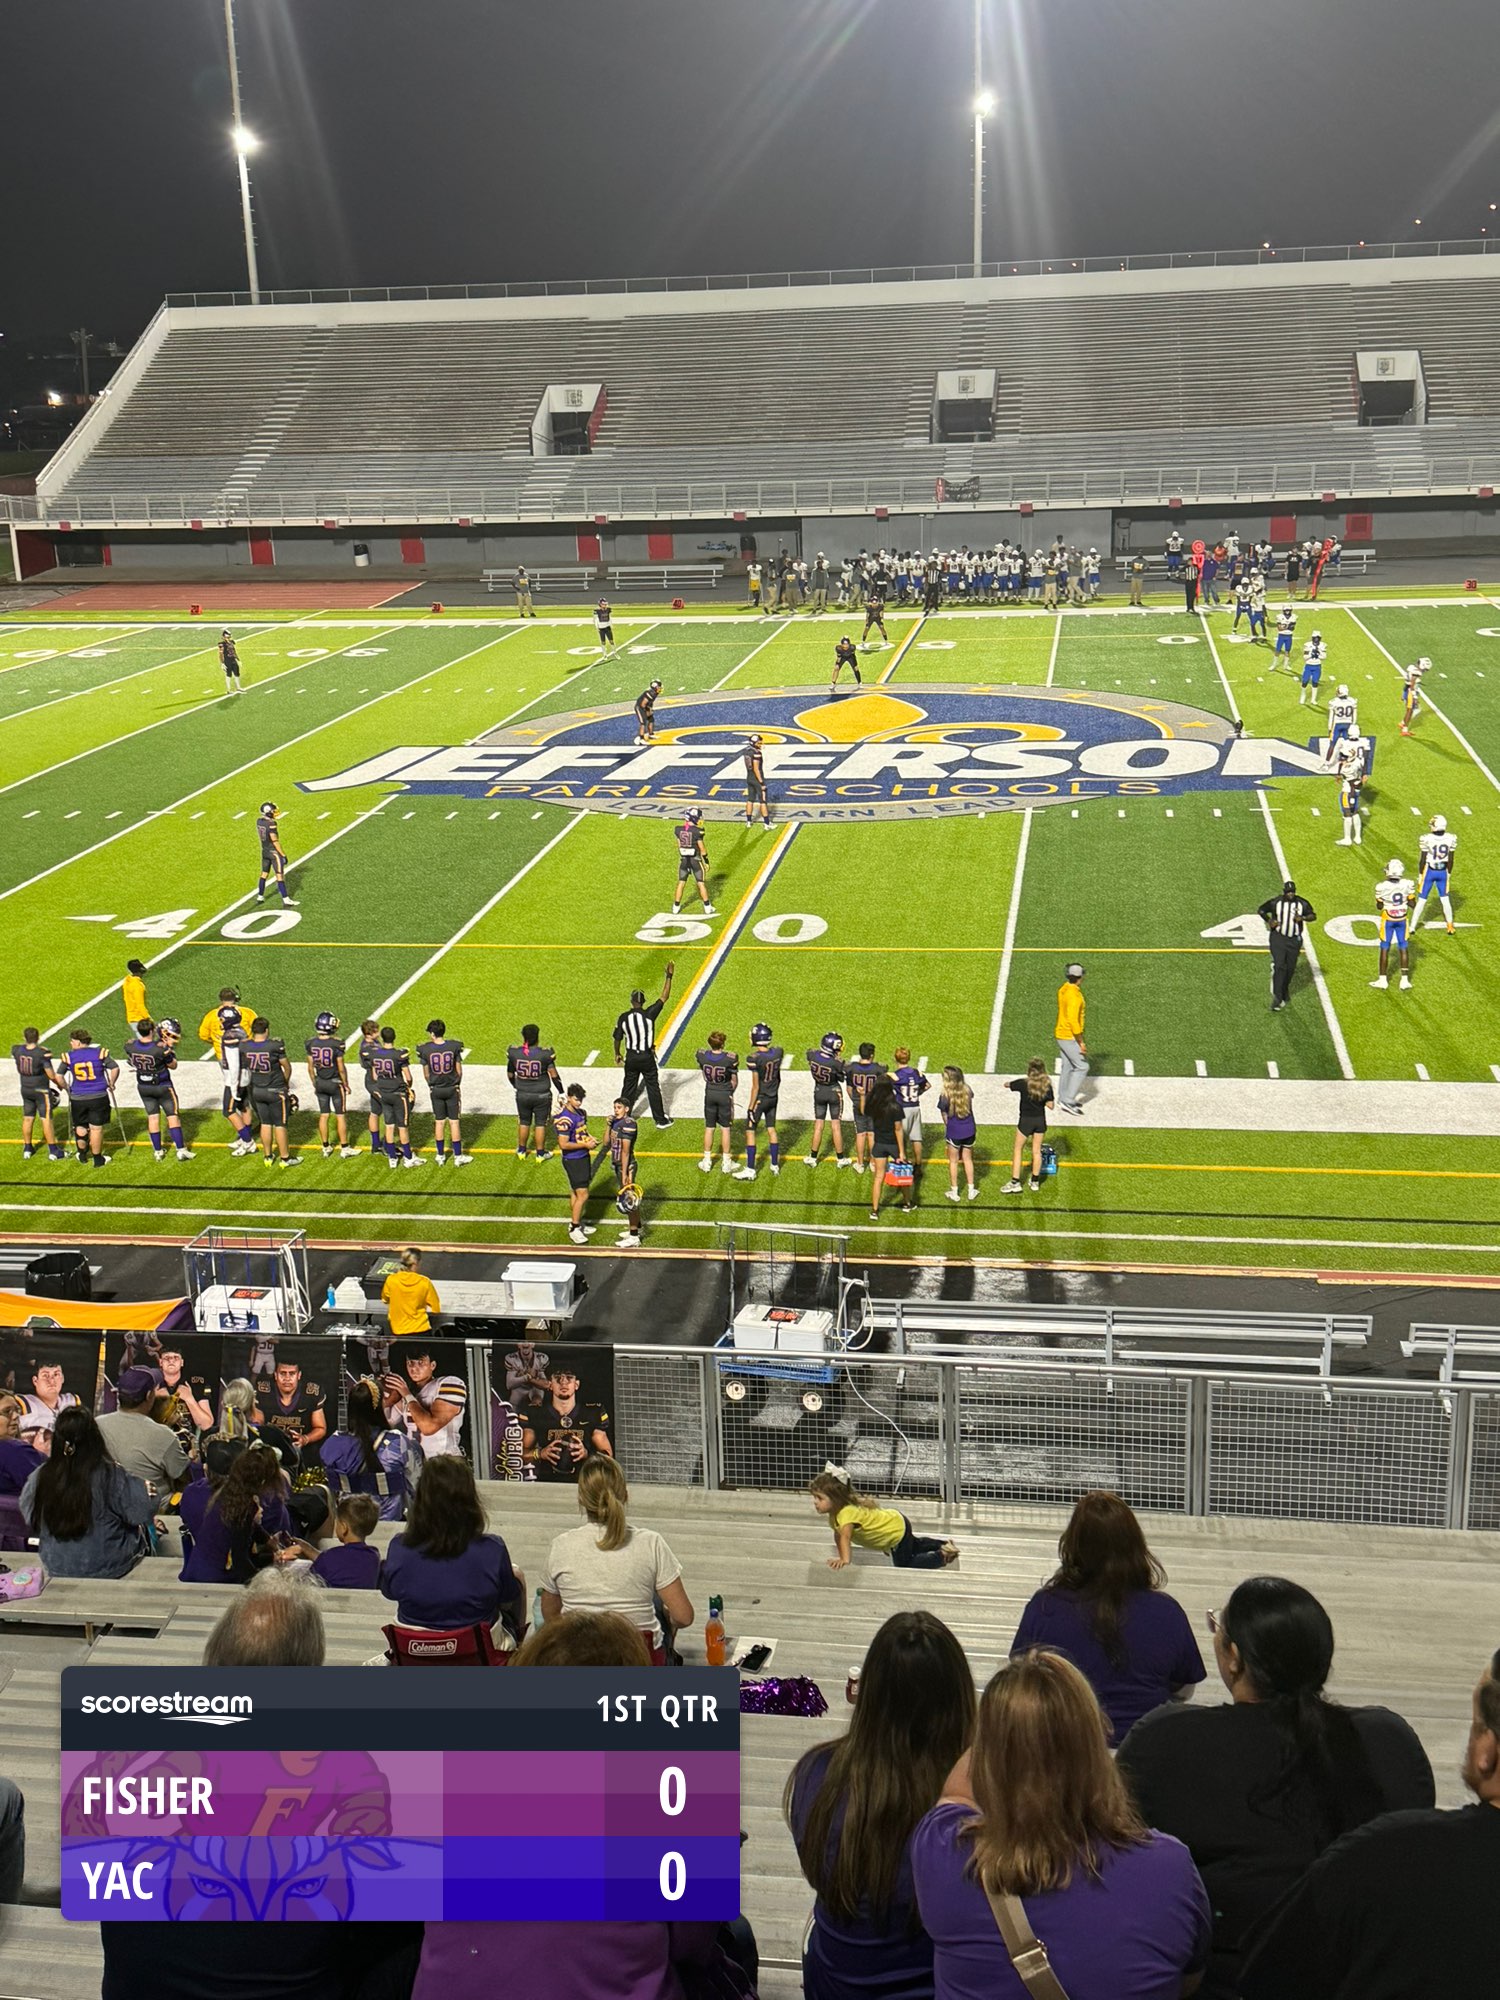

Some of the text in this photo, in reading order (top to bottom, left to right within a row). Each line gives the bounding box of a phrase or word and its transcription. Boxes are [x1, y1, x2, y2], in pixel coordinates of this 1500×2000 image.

[1336, 705, 1353, 718] 30
[299, 736, 1370, 792] JEFFERSON
[484, 782, 1162, 798] PARISH SCHOOLS
[608, 800, 708, 819] LOV
[907, 798, 1016, 815] LEAD
[1432, 844, 1449, 860] 19
[1391, 892, 1403, 907] 9
[634, 911, 829, 943] 50
[19, 1055, 33, 1076] 11
[247, 1052, 271, 1073] 75
[311, 1047, 333, 1068] 28
[430, 1051, 454, 1075] 88
[73, 1061, 96, 1081] 51
[516, 1059, 542, 1079] 58
[702, 1064, 727, 1084] 86
[810, 1061, 832, 1086] 25
[411, 1642, 446, 1652] Coleman
